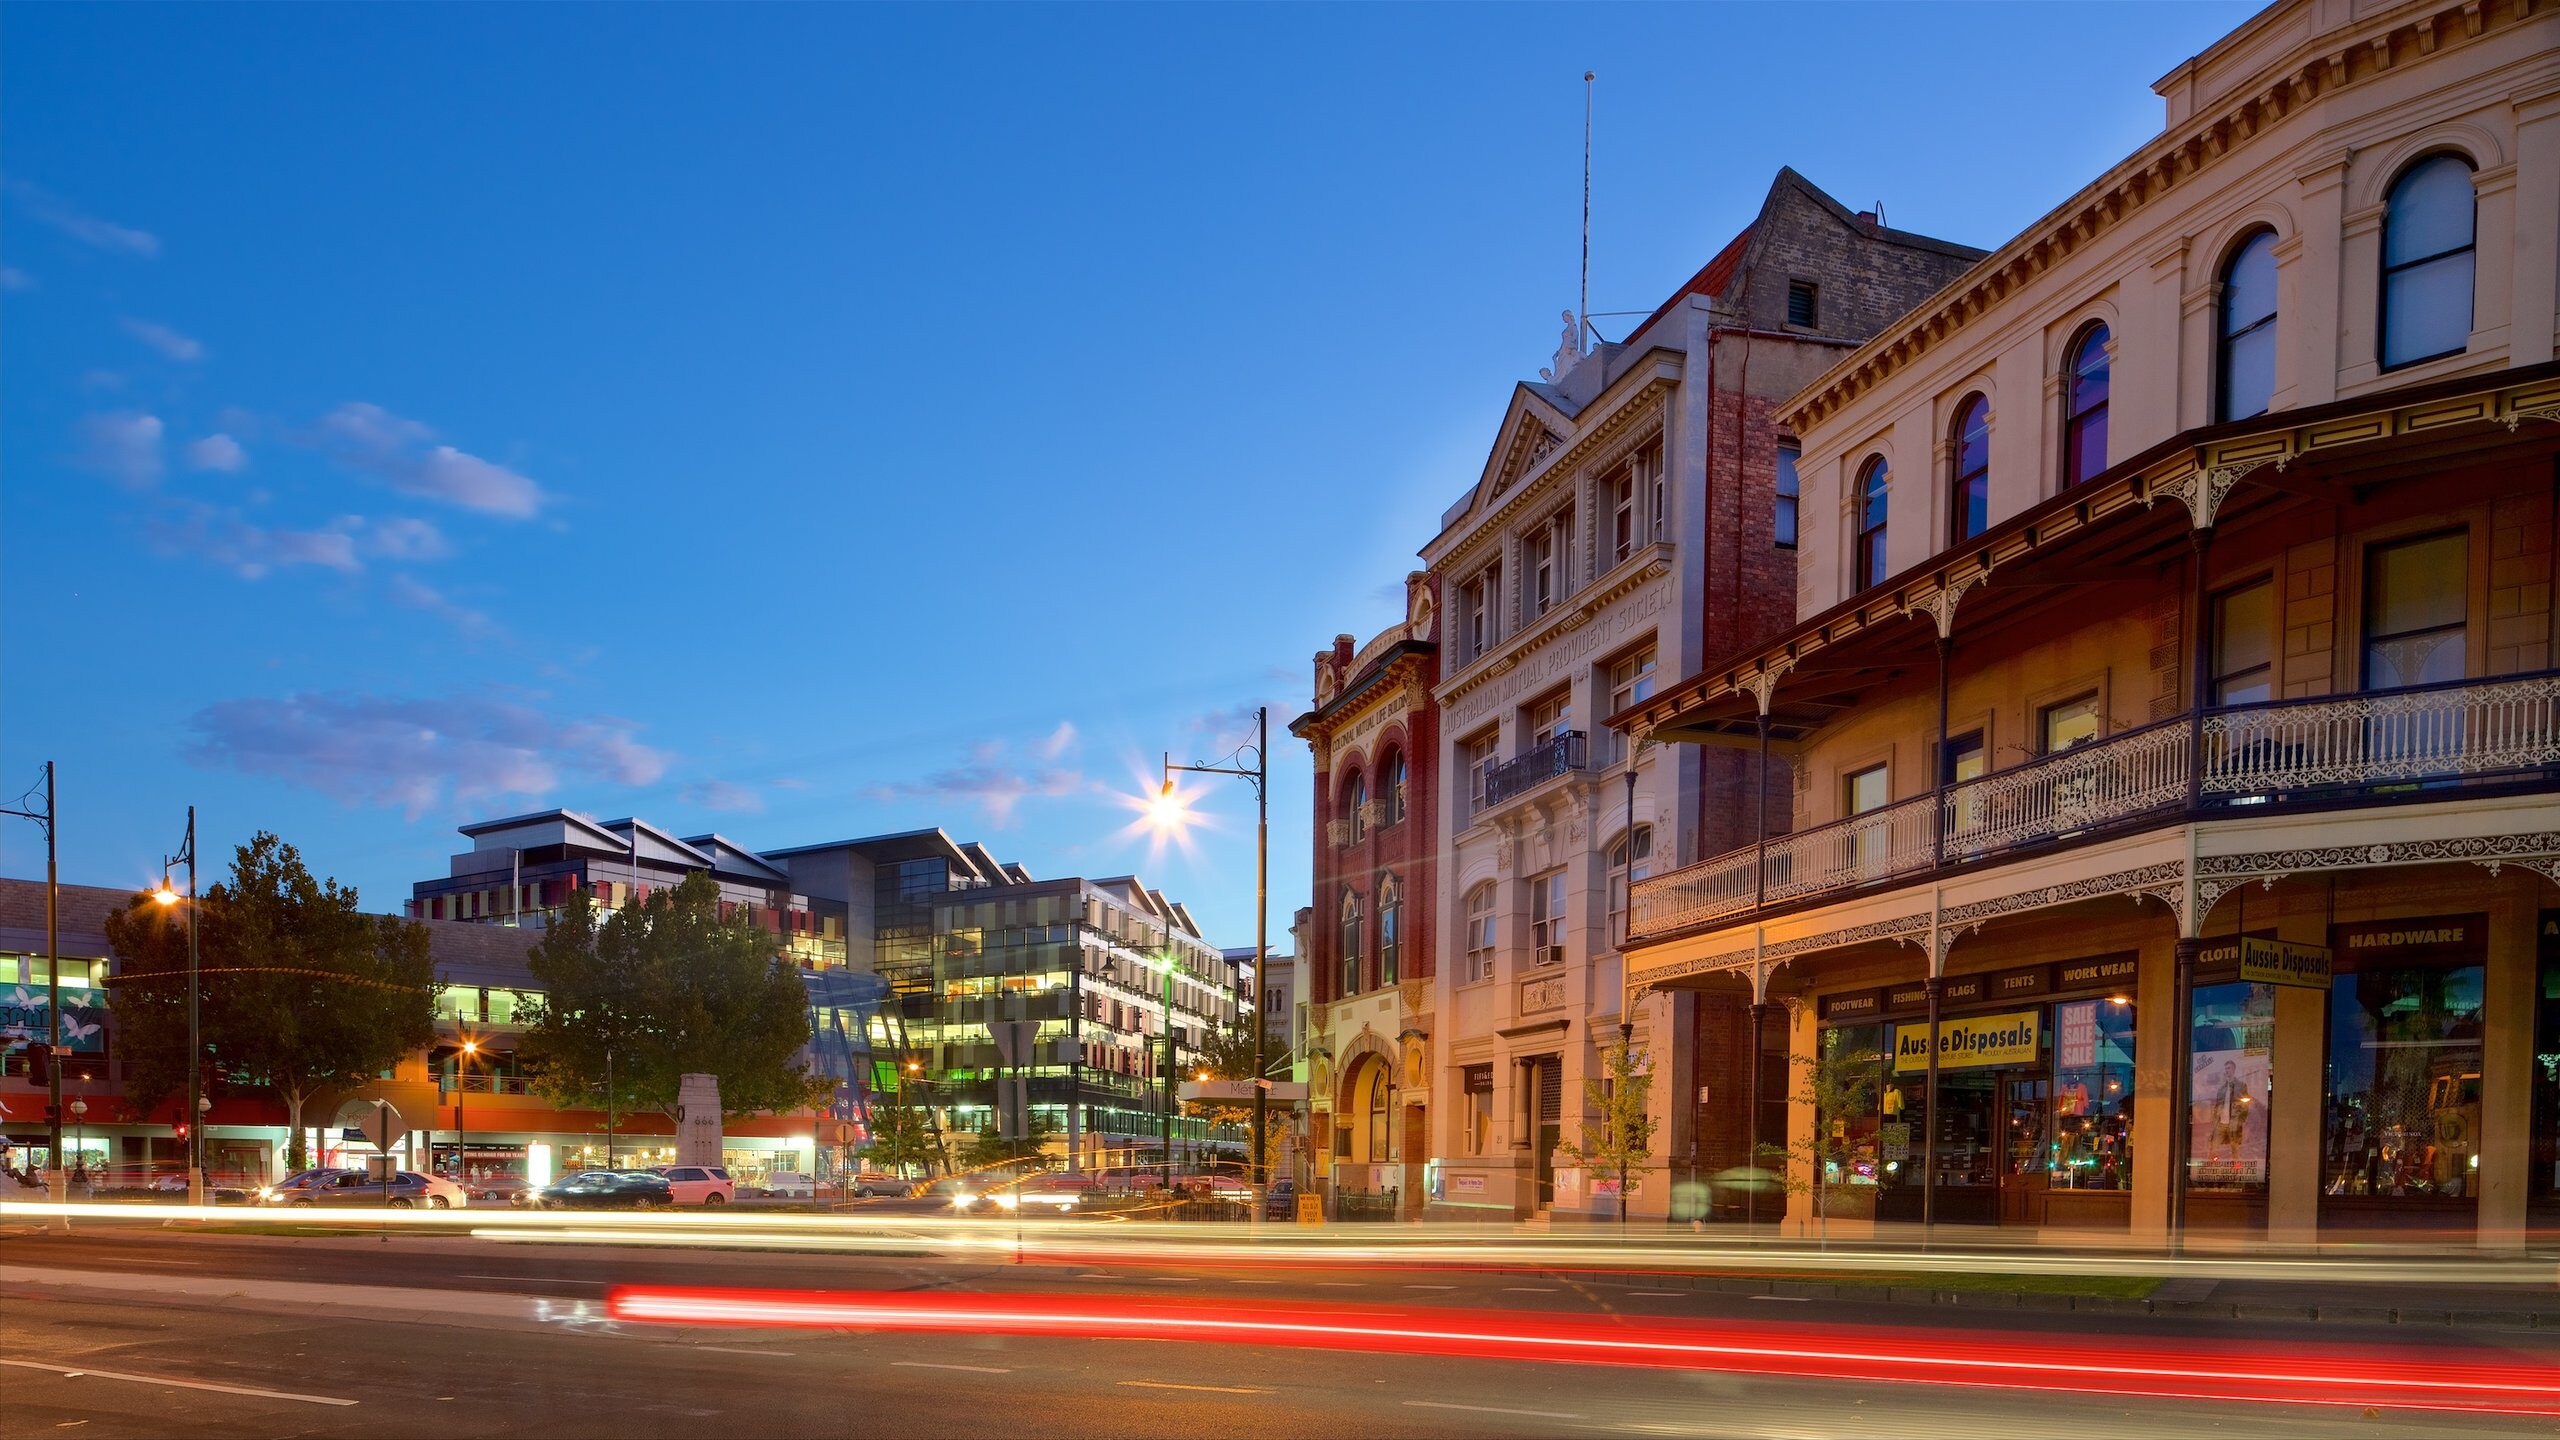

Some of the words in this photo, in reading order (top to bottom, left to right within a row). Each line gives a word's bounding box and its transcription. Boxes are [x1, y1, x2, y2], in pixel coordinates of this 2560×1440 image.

[1444, 684, 1500, 737] AUSTRALIAN
[1502, 659, 1544, 702] MUTUAL
[1547, 616, 1613, 676] PROVIDENT
[1618, 576, 1675, 634] SOCIETY
[2349, 928, 2464, 948] HARDWARE
[2199, 946, 2239, 963] CLOTH
[2244, 941, 2279, 970] Aussie
[2281, 946, 2330, 980] Disposals
[2063, 966, 2098, 982] WORK
[2100, 961, 2135, 977] WEAR
[1947, 984, 1976, 998] FLAGS
[2003, 975, 2035, 989] TENTS
[1831, 997, 1874, 1012] FOOTWEAR
[1892, 990, 1926, 1004] FISHING
[2064, 1004, 2094, 1025] SALE
[1900, 1034, 1949, 1056] Ause
[1952, 1021, 2032, 1055] Disposals
[2064, 1024, 2093, 1045] SALE
[1909, 1056, 1929, 1064] OUTDOO
[2063, 1045, 2092, 1066] SALE
[1230, 1083, 1279, 1096] Méter
